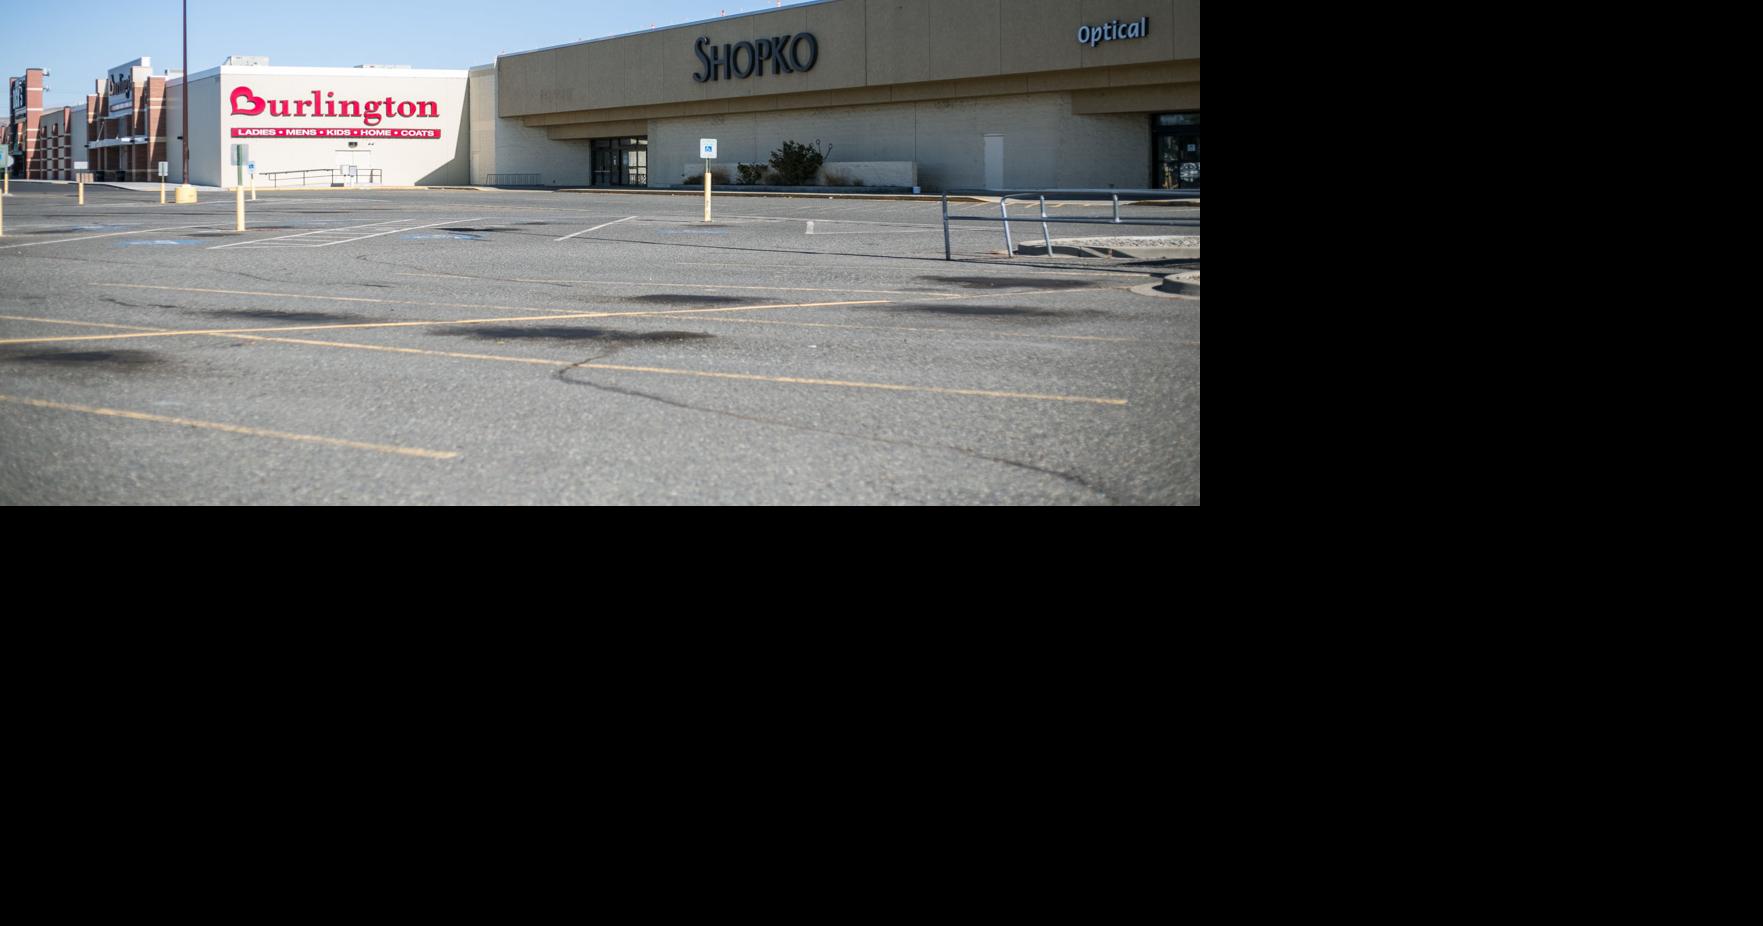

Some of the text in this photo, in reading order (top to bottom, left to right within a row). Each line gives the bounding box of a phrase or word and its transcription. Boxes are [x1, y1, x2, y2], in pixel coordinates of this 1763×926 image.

[1077, 16, 1149, 47] Optical
[692, 32, 819, 83] SHOPKO
[229, 86, 440, 127] Burlington
[237, 128, 435, 137] LADIES MENS KIDS HOME COATS
